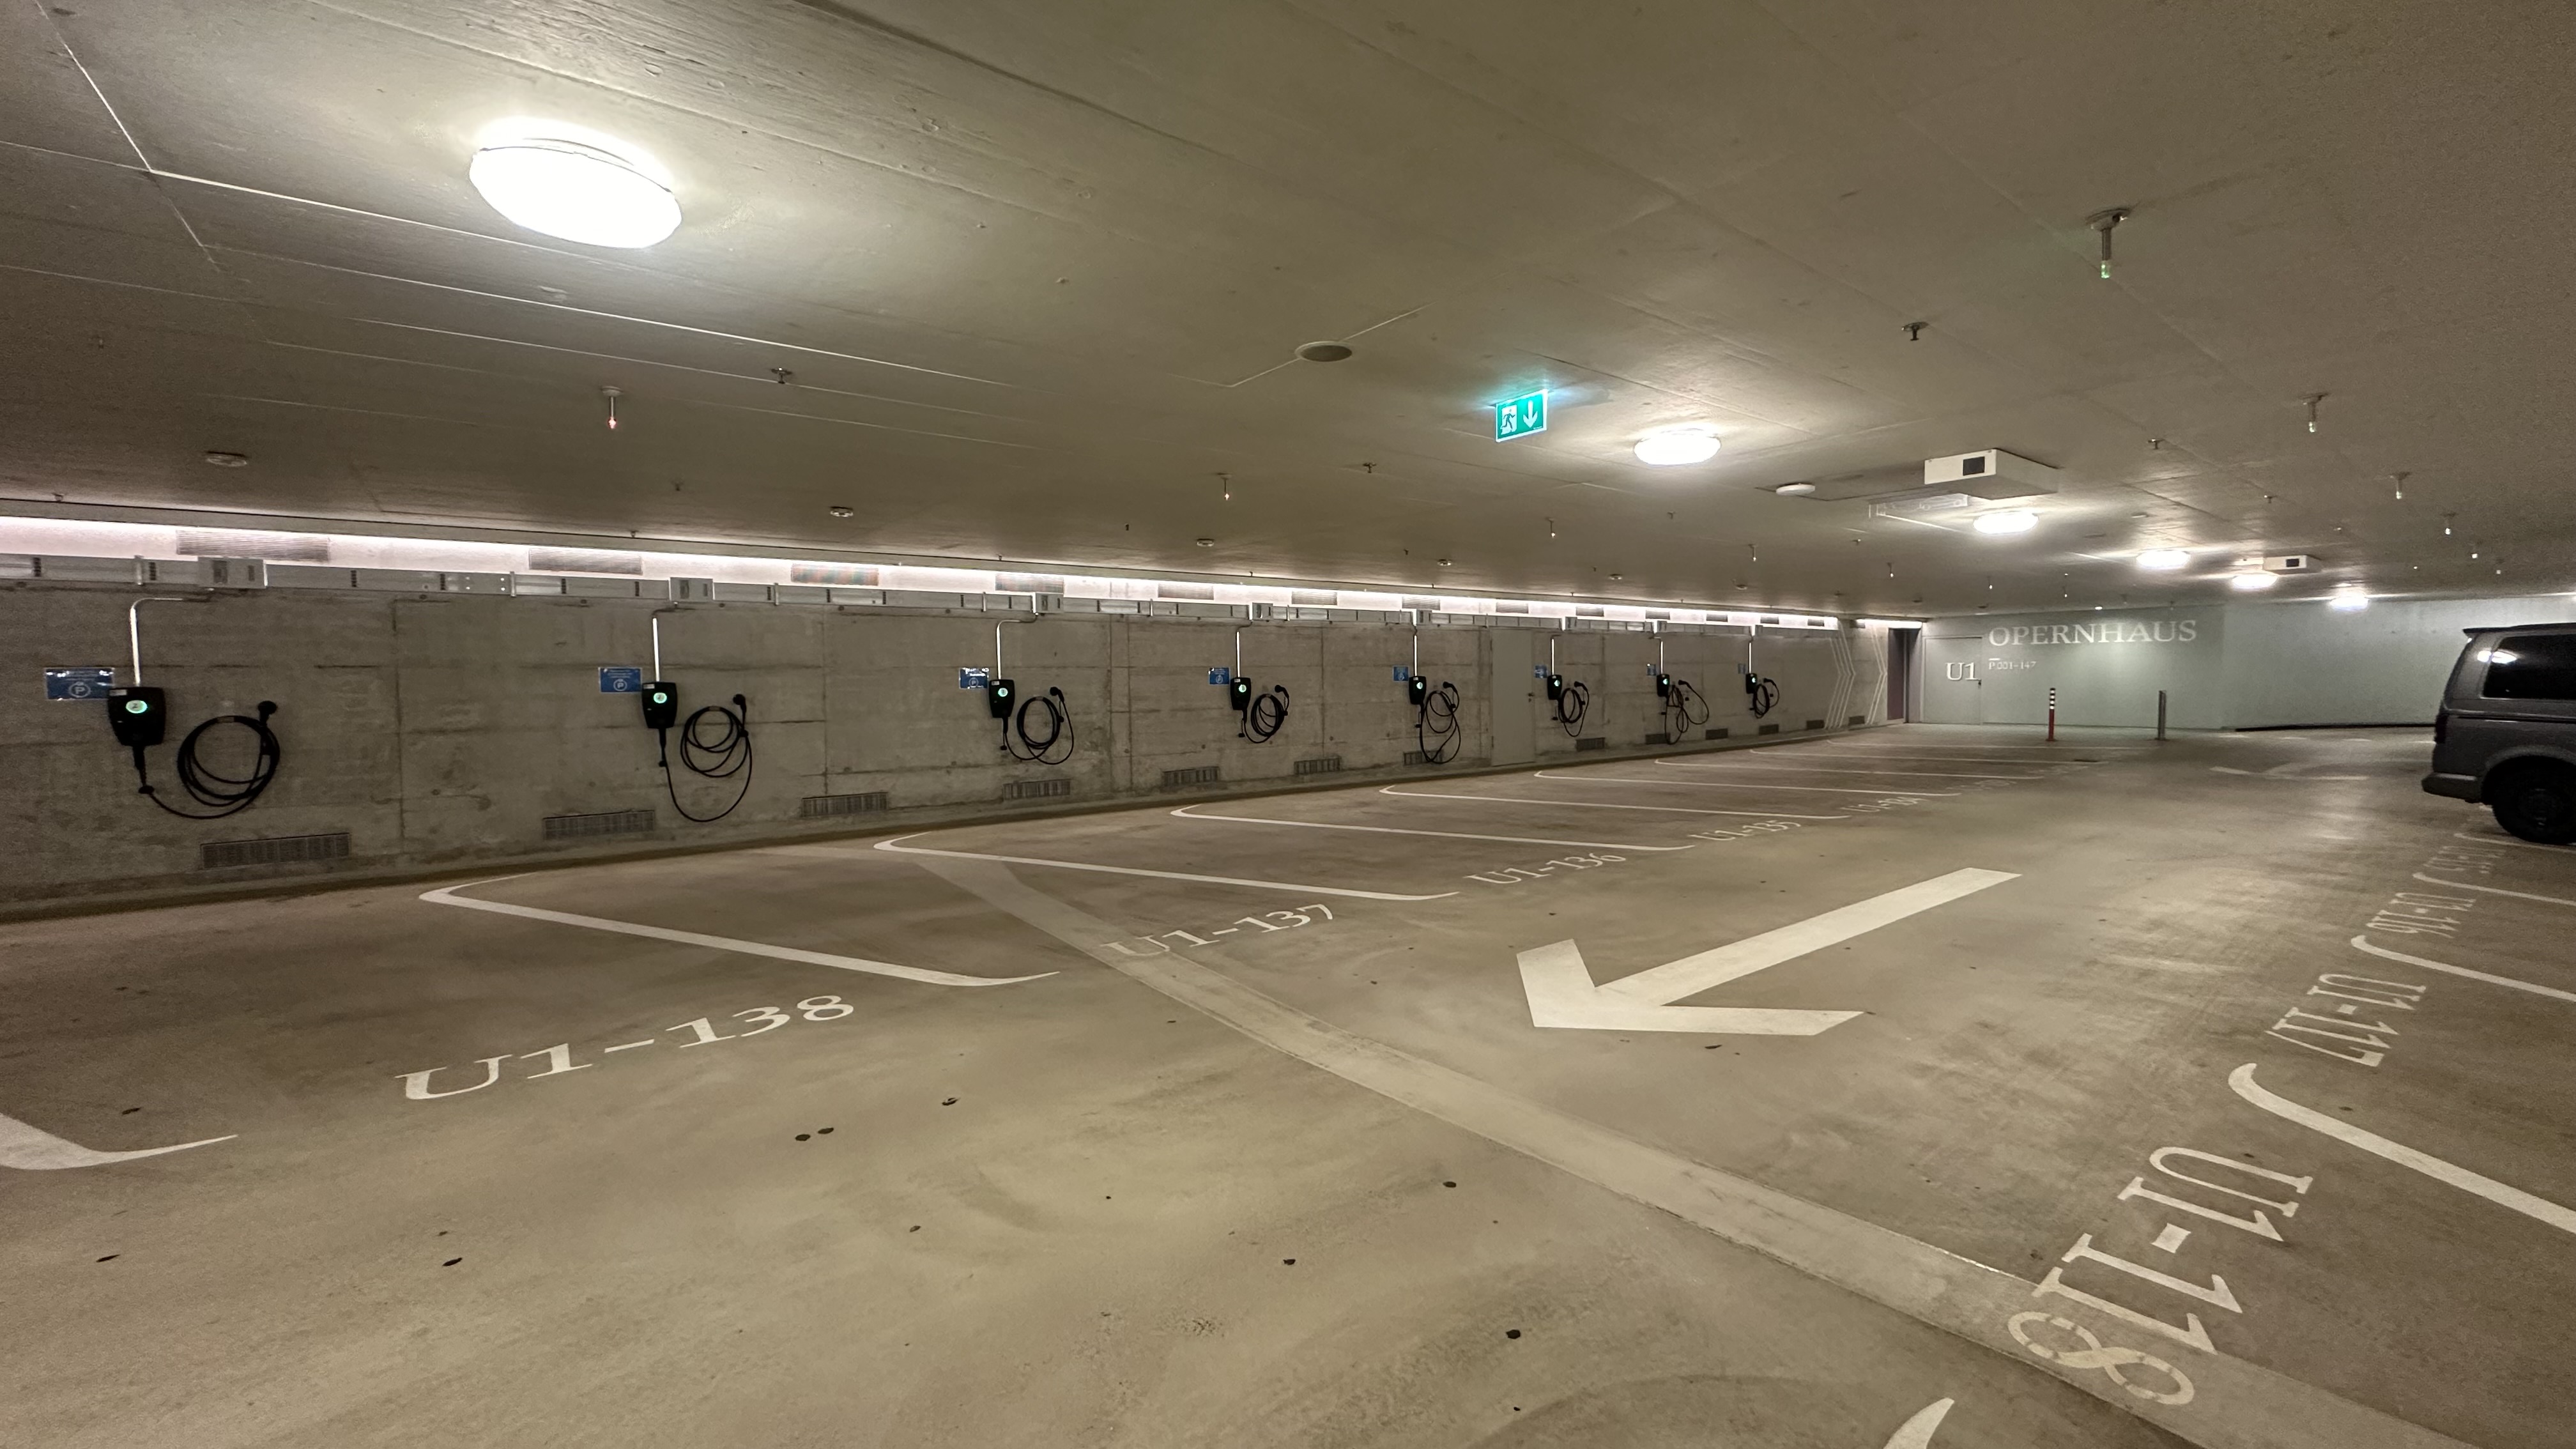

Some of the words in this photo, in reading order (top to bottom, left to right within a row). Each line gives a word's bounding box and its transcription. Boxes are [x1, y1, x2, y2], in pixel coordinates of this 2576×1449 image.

[1989, 620, 2196, 647] OPERNHAUS
[1945, 663, 1980, 682] U1
[1687, 820, 1801, 841] U1-135
[1463, 852, 1627, 885] U1-136
[1100, 903, 1334, 956] U1-137
[2366, 893, 2476, 938] U1-116
[2264, 974, 2426, 1067] U1-117
[395, 995, 854, 1100] U1-138
[2007, 1147, 2313, 1406] U1-118
